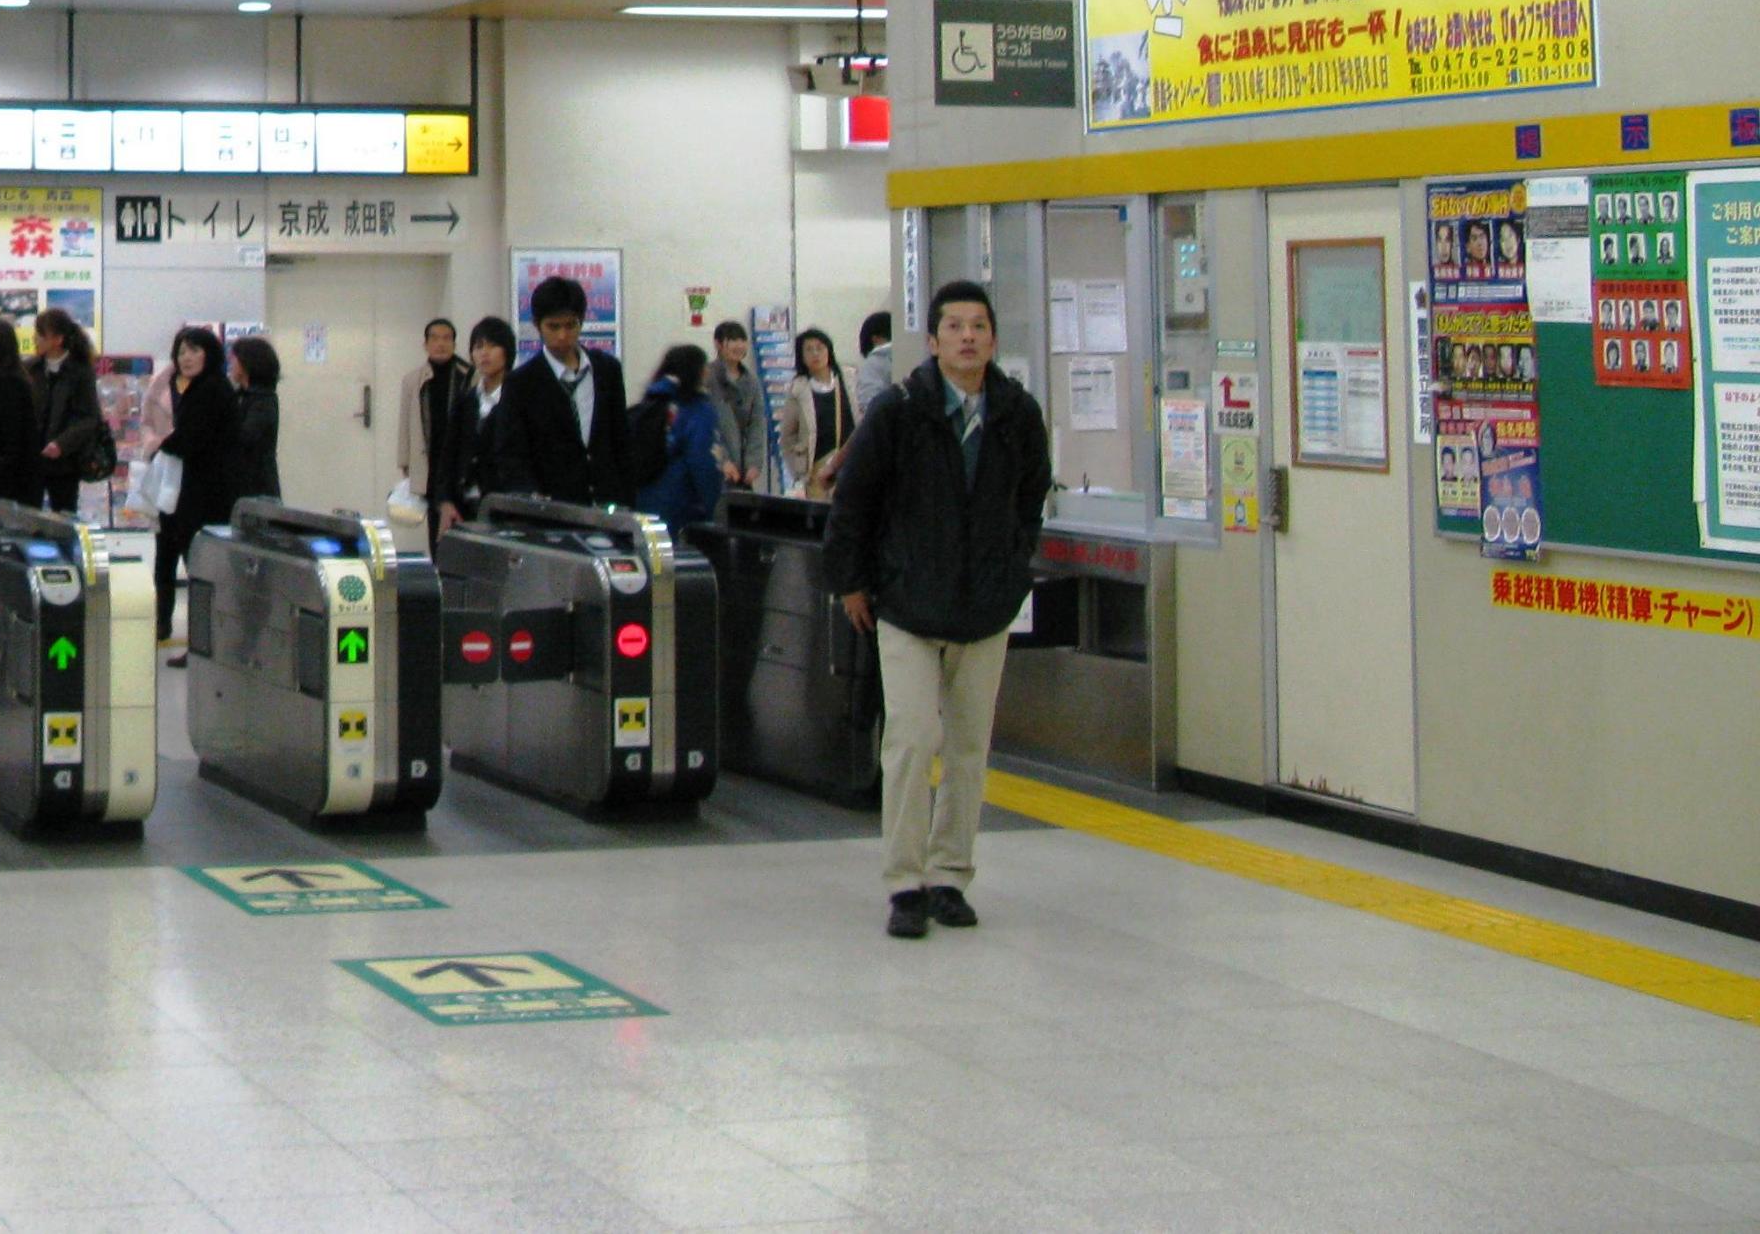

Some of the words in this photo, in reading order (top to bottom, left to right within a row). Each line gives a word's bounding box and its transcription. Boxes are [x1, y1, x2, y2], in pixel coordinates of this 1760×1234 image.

[996, 24, 1067, 41] うらが白色の
[166, 199, 256, 240] トイレ
[278, 199, 330, 238] 京成
[344, 199, 397, 237] 成田駅
